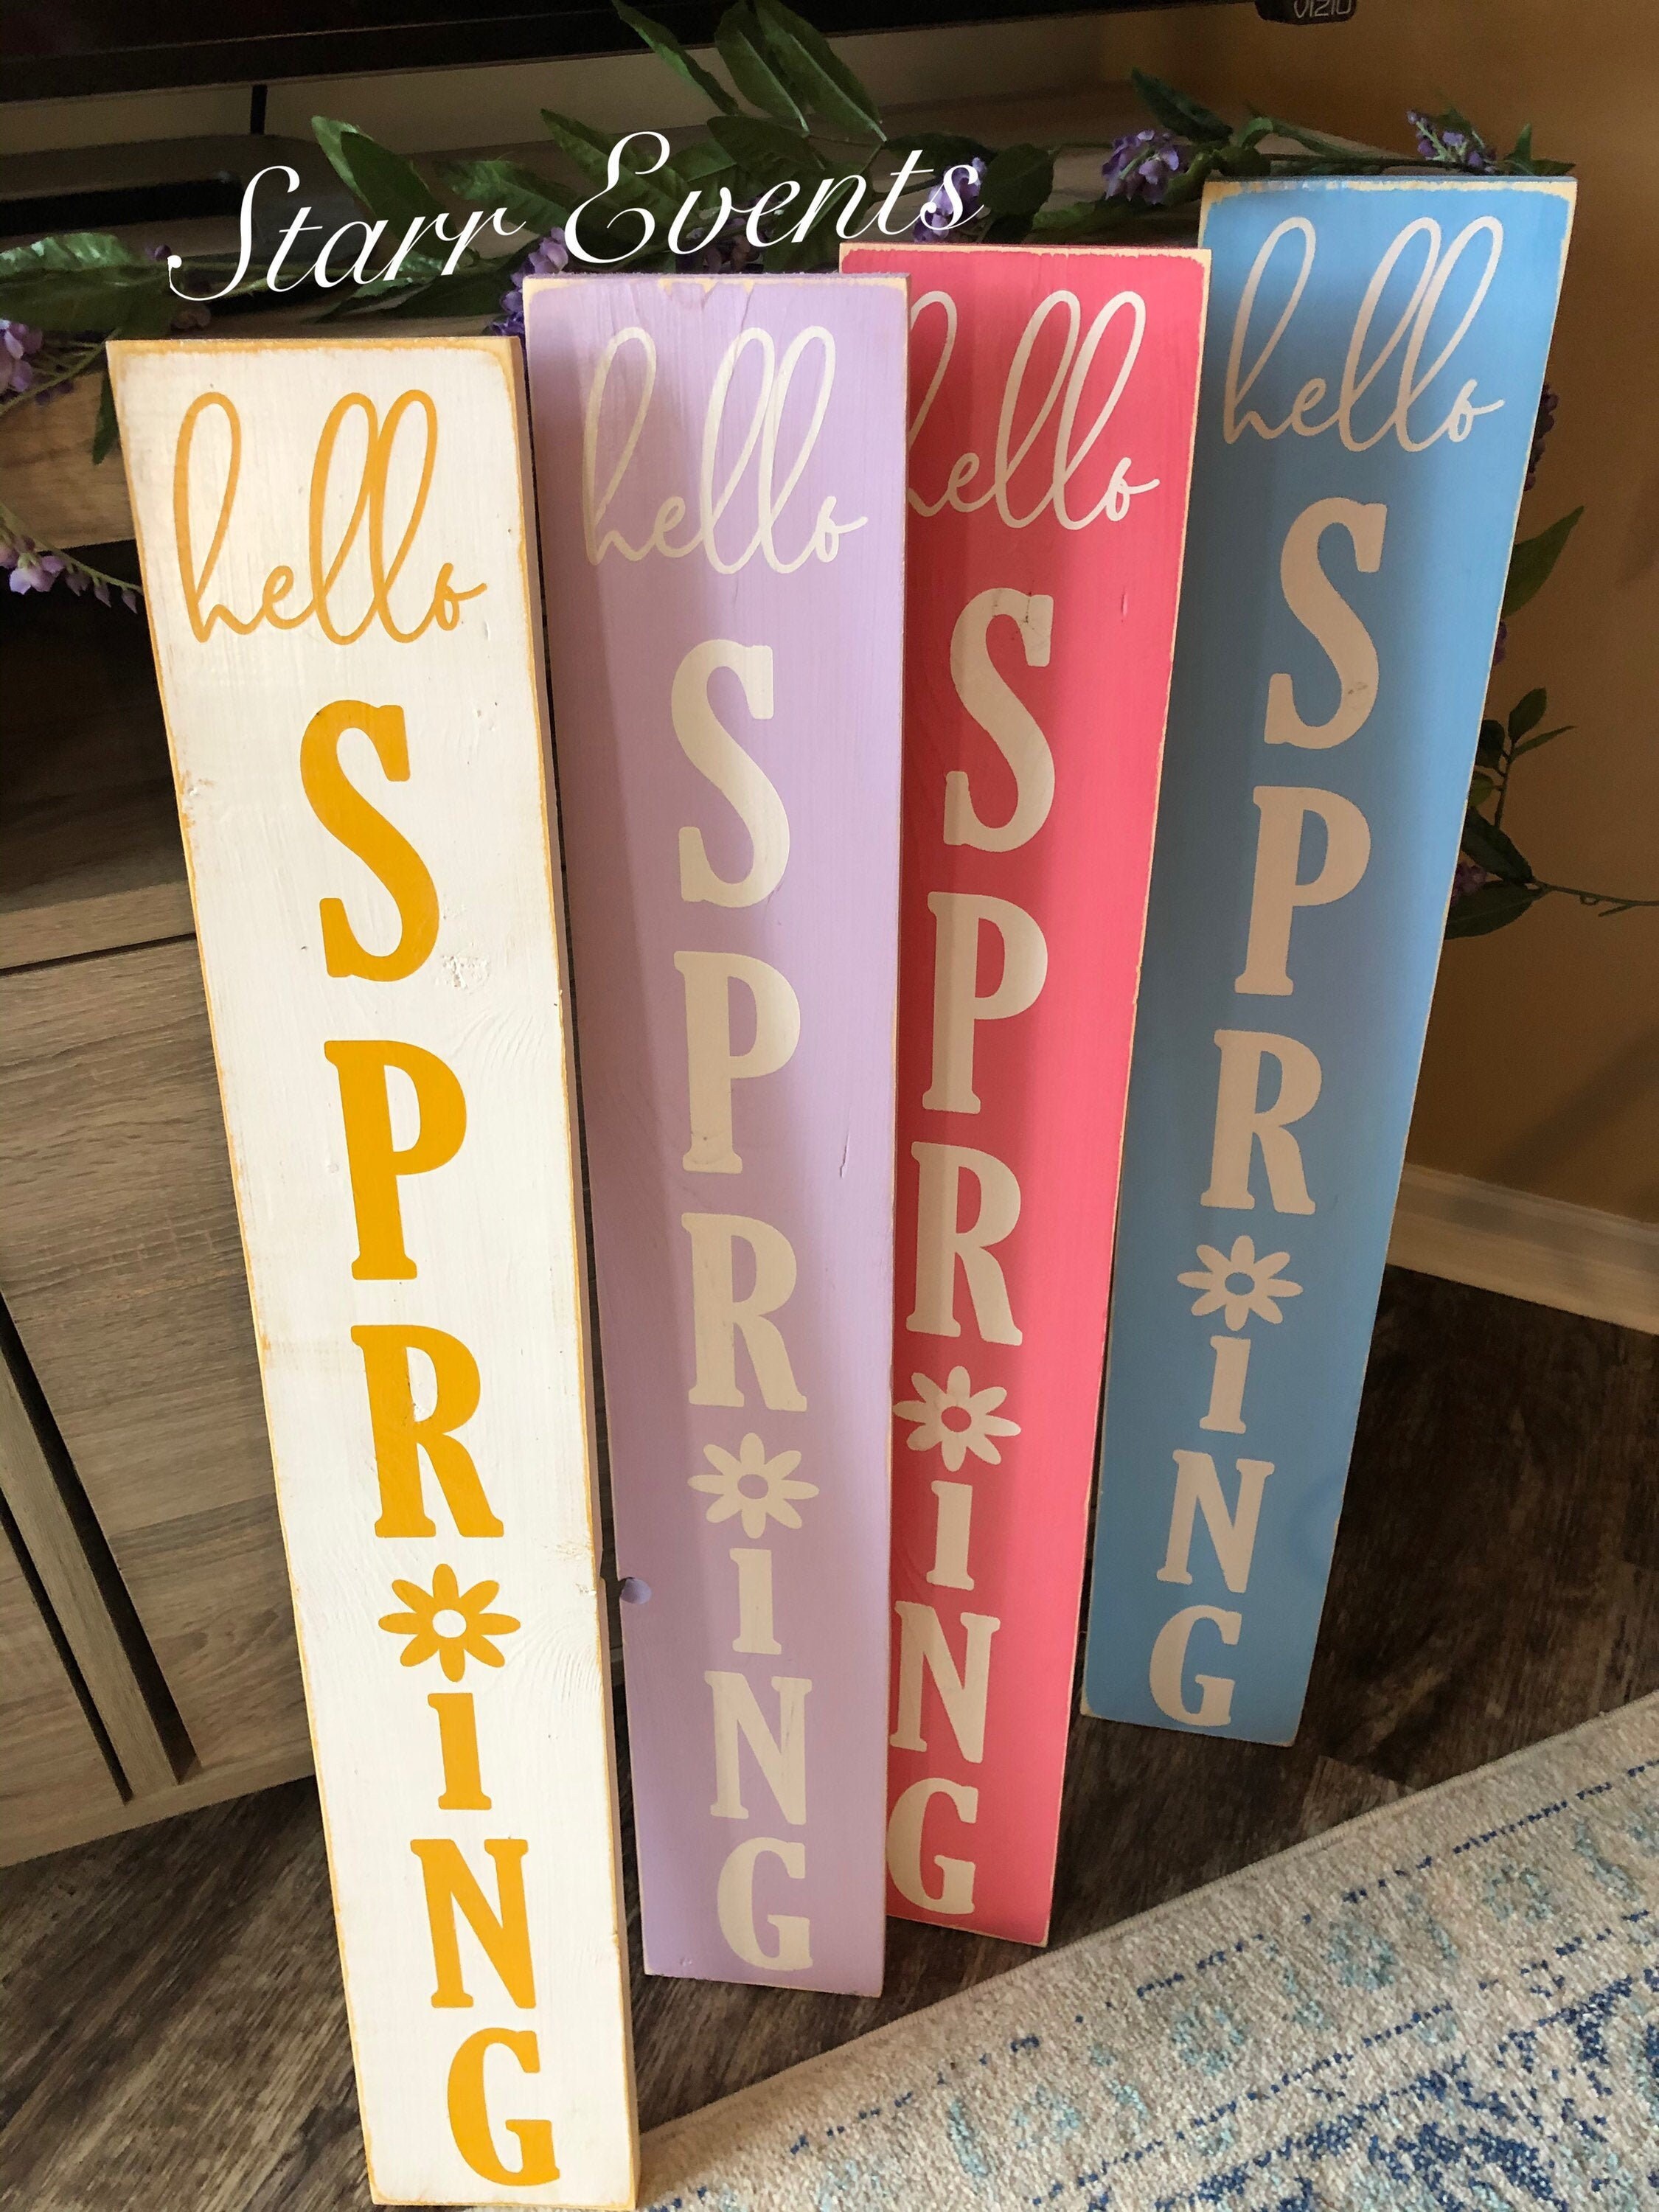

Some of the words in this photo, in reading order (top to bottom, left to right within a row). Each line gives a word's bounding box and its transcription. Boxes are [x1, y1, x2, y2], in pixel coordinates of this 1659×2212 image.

[583, 327, 867, 574] hello
[1224, 217, 1504, 453] hello
[176, 390, 487, 643] hello
